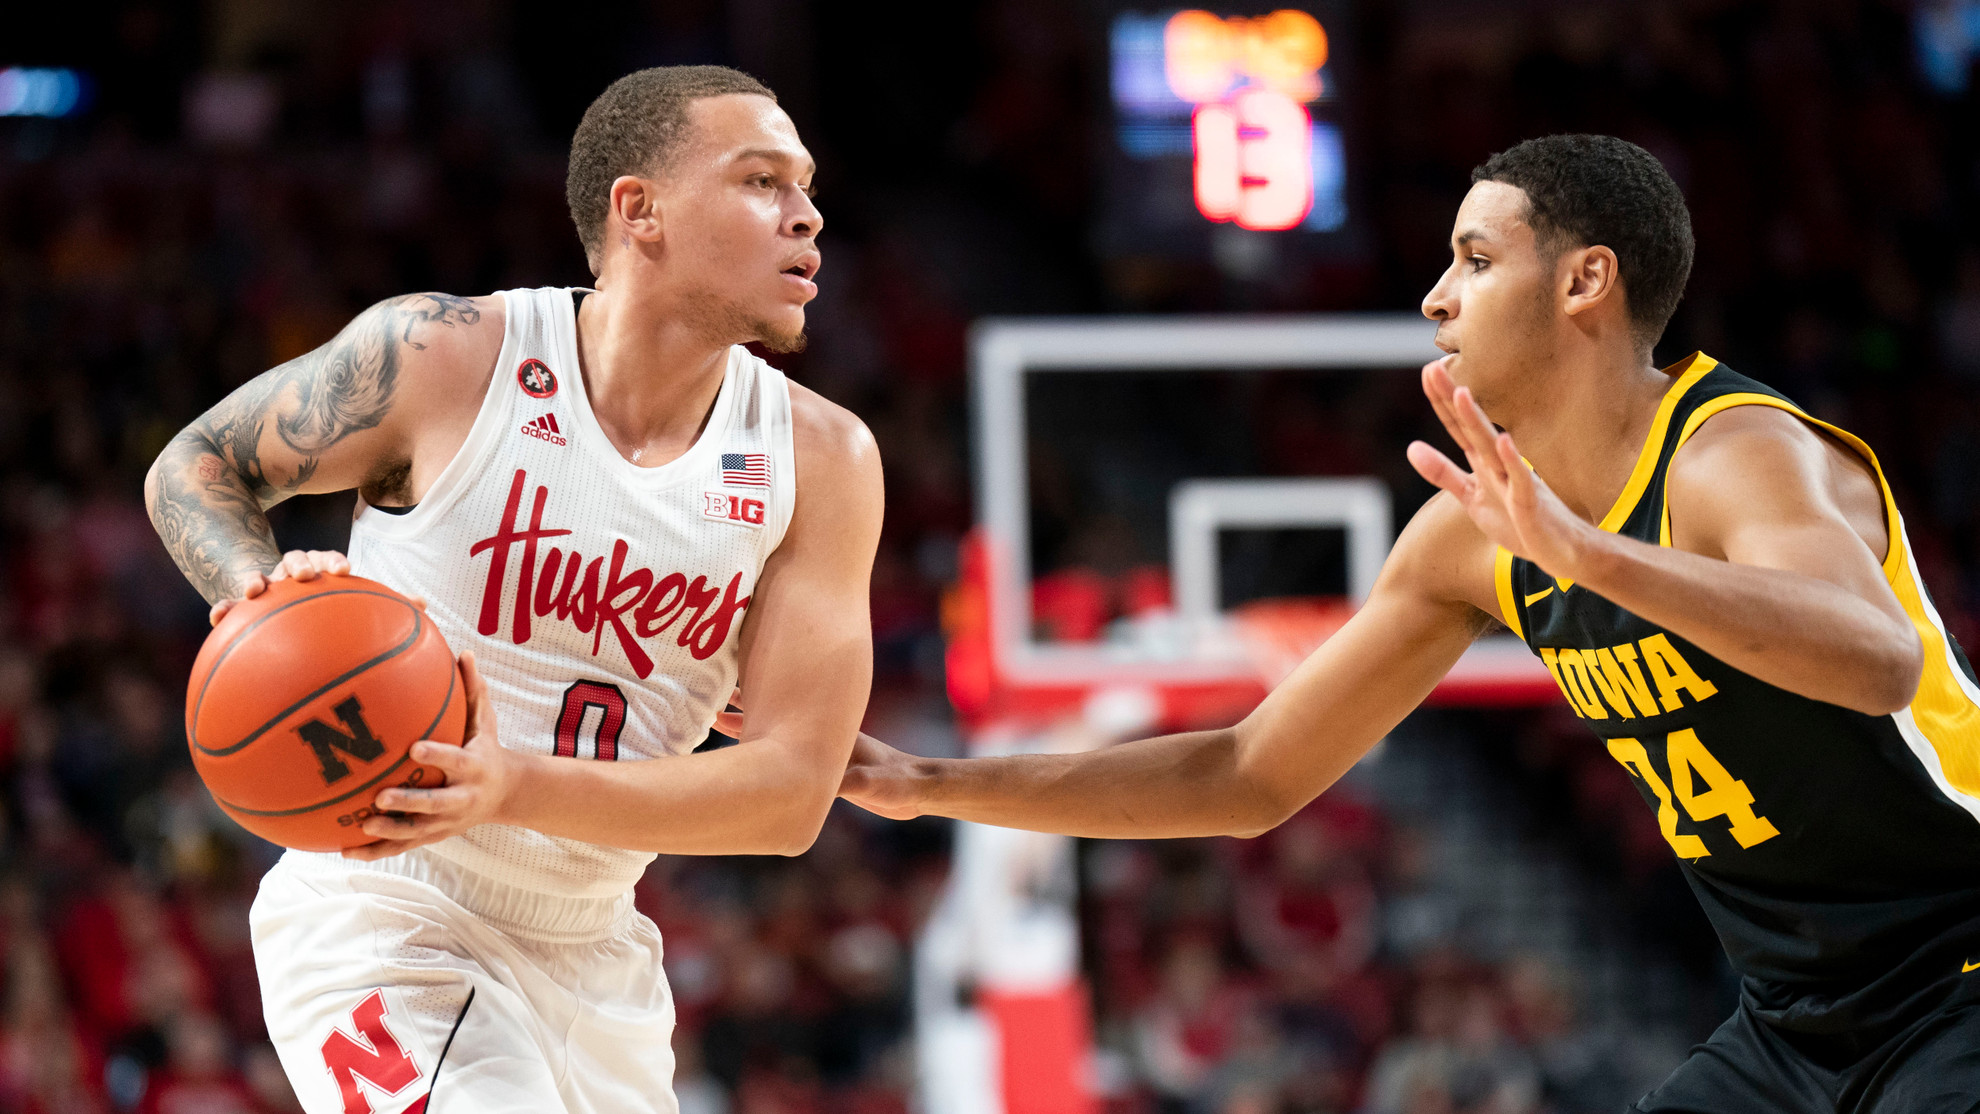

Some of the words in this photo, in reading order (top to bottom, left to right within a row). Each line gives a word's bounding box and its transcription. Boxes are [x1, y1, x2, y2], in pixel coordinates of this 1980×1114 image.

[520, 425, 567, 446] adidas
[469, 468, 751, 680] Huskers
[553, 678, 629, 761] 0
[1539, 632, 1719, 720] IOWA
[290, 691, 388, 787] N
[1606, 727, 1781, 860] 24
[320, 987, 424, 1114] N
